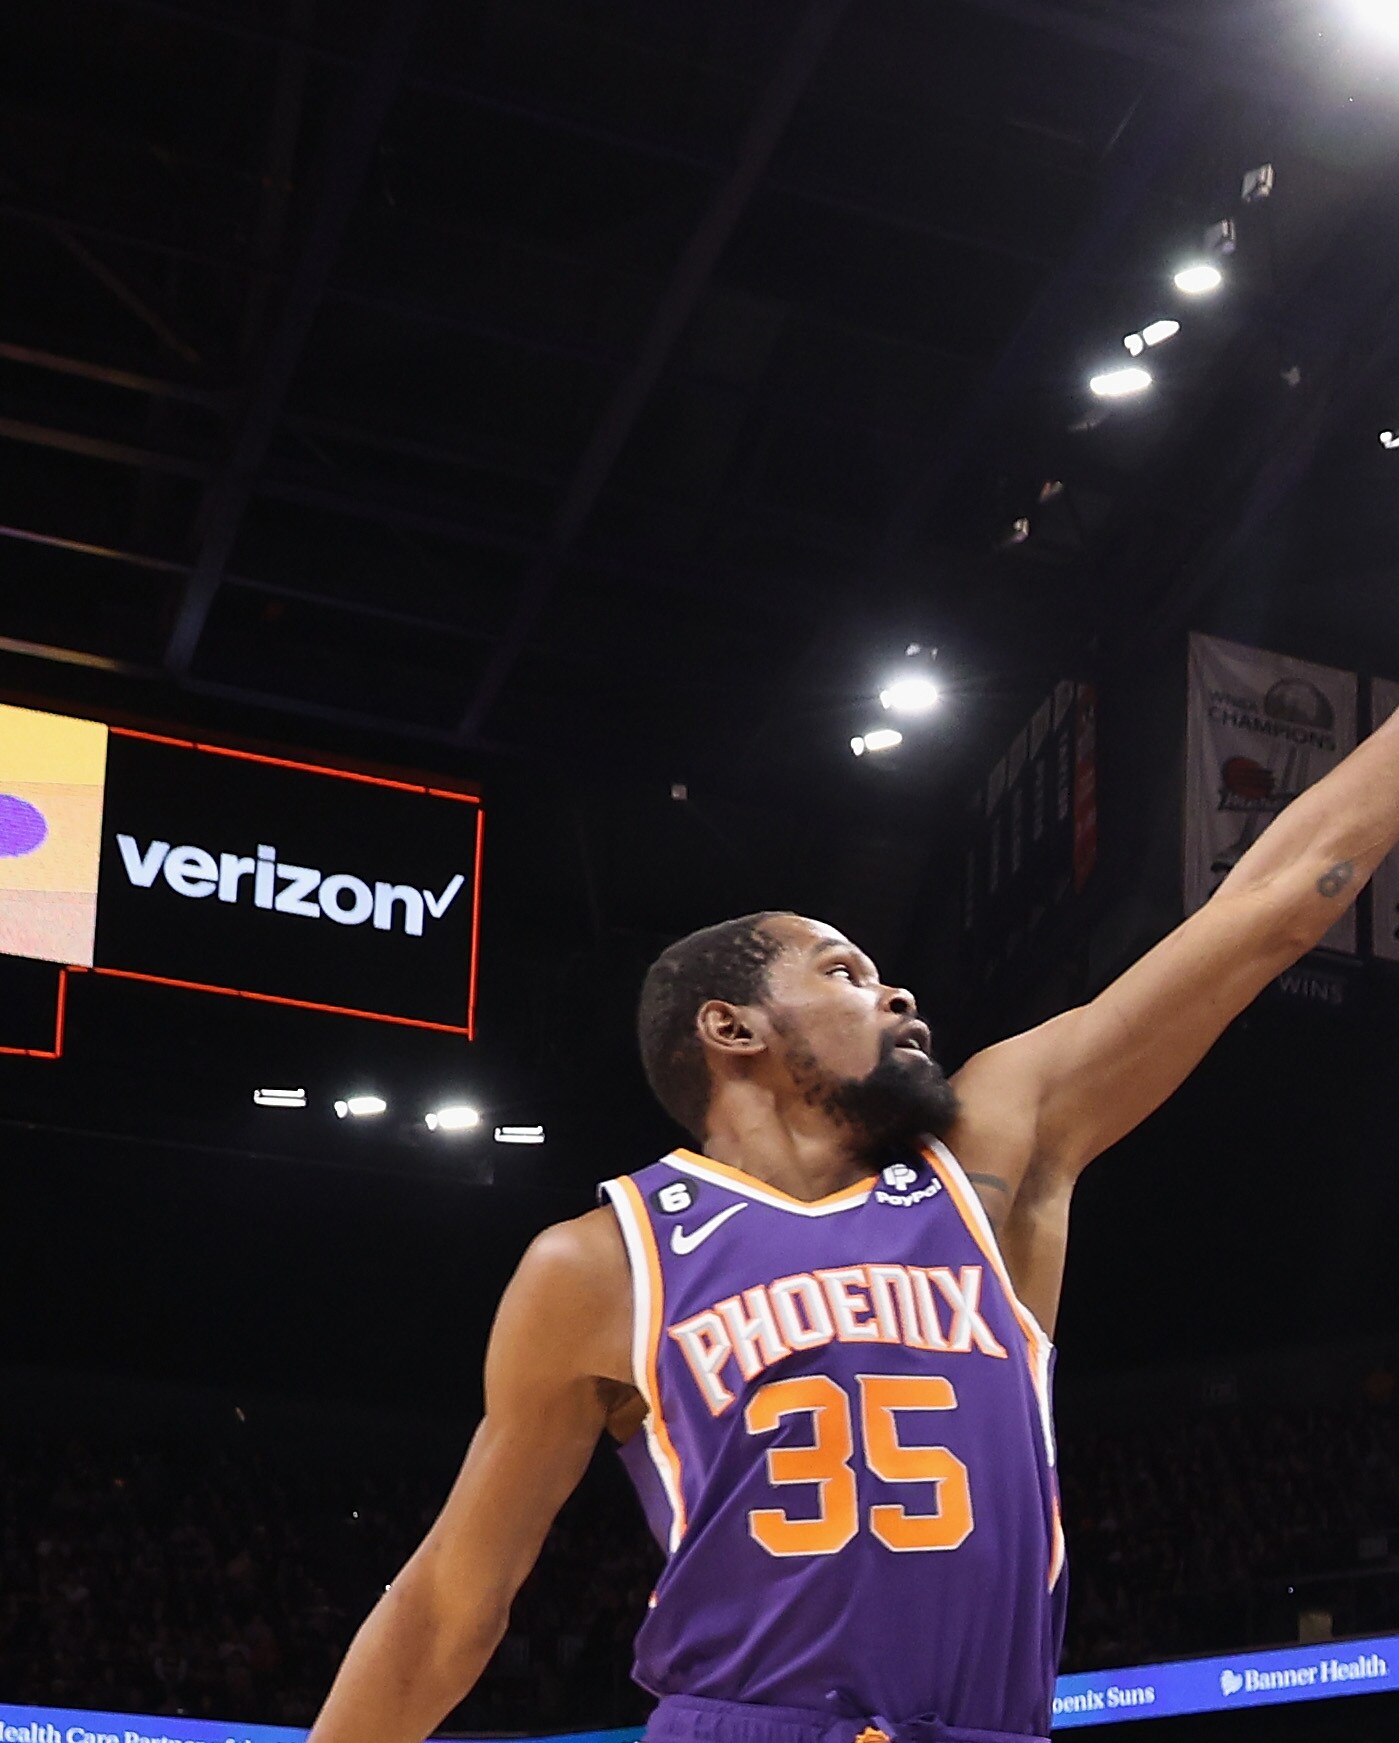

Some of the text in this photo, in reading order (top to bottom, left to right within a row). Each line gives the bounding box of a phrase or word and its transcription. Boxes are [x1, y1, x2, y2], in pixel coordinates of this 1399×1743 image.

[1207, 704, 1336, 751] CHAMPIONS
[116, 833, 424, 936] verizon
[1278, 973, 1343, 1003] WINS
[658, 1182, 692, 1213] 6
[668, 1263, 1008, 1418] PHOENIX
[744, 1374, 975, 1558] 35
[1245, 1654, 1387, 1693] Banner Health
[1052, 1684, 1156, 1715] oenix Suns
